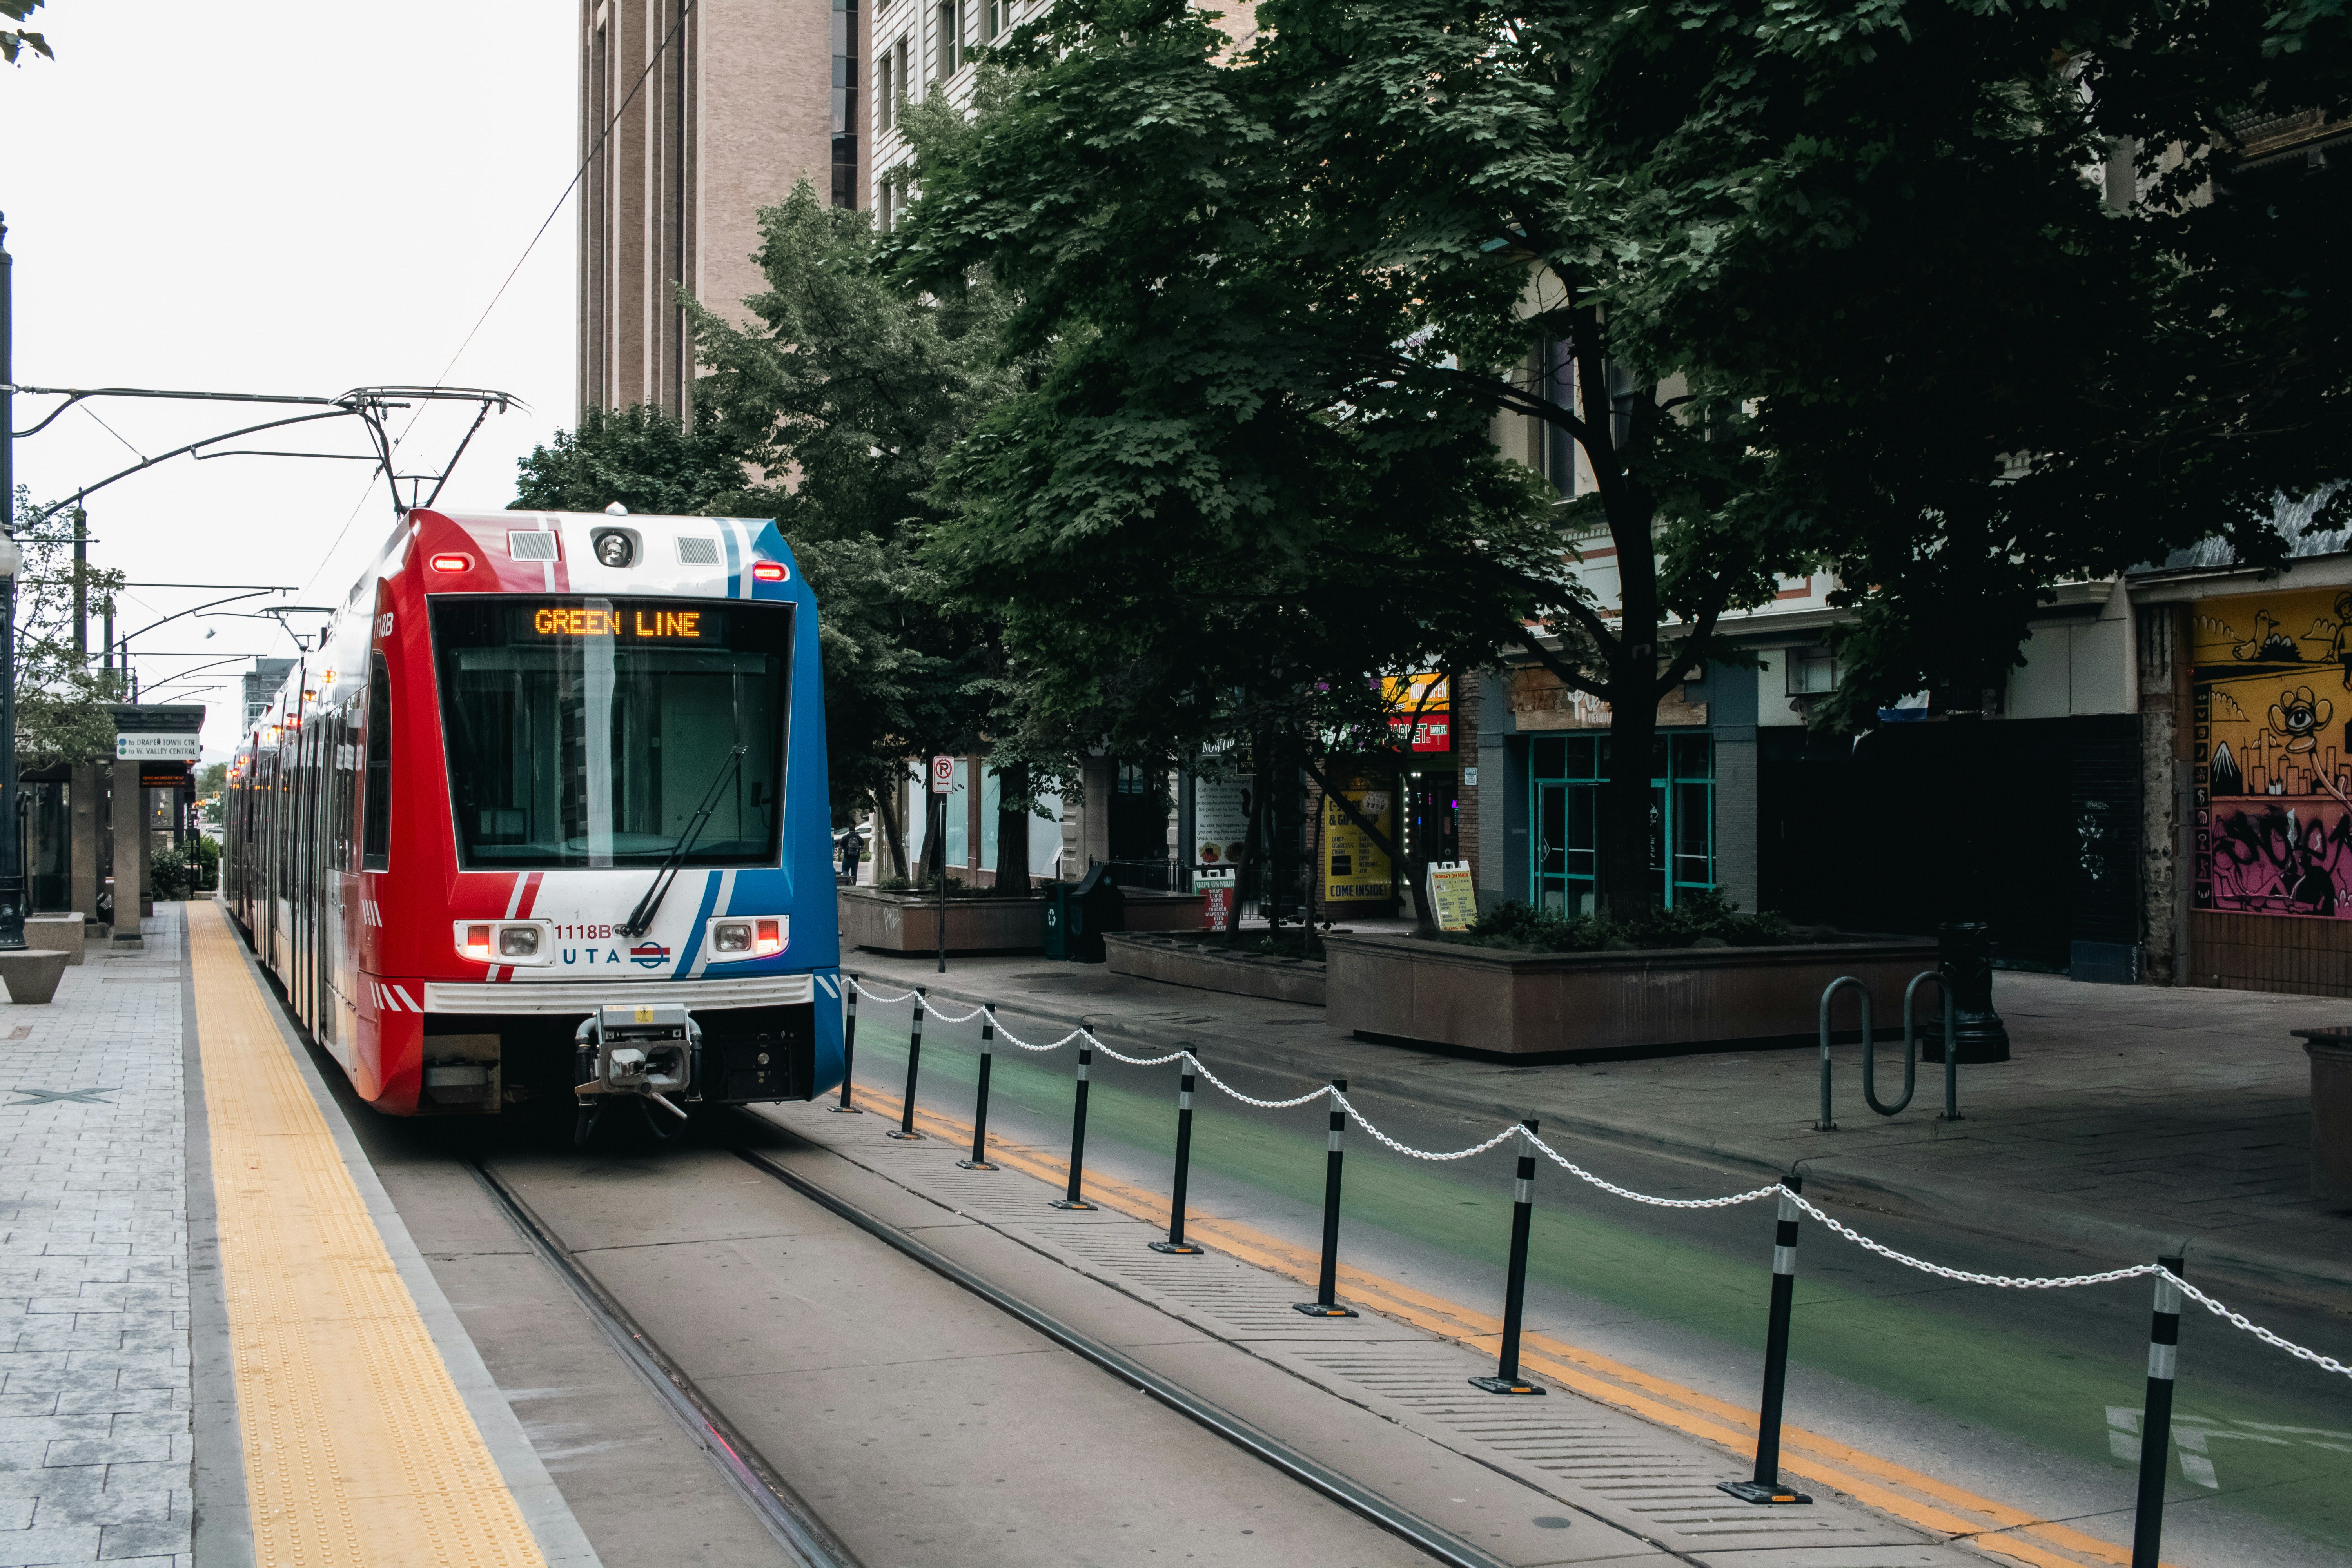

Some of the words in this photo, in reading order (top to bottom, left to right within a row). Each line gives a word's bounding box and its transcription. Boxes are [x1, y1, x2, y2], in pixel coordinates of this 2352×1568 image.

[374, 612, 394, 640] 1118B
[535, 610, 620, 635] GREEN
[637, 611, 700, 636] LINE
[1329, 814, 1336, 825] &
[1330, 884, 1354, 897] COME
[1356, 884, 1387, 897] INSIDE!
[555, 924, 611, 939] 1118B
[563, 948, 621, 964] UTA
